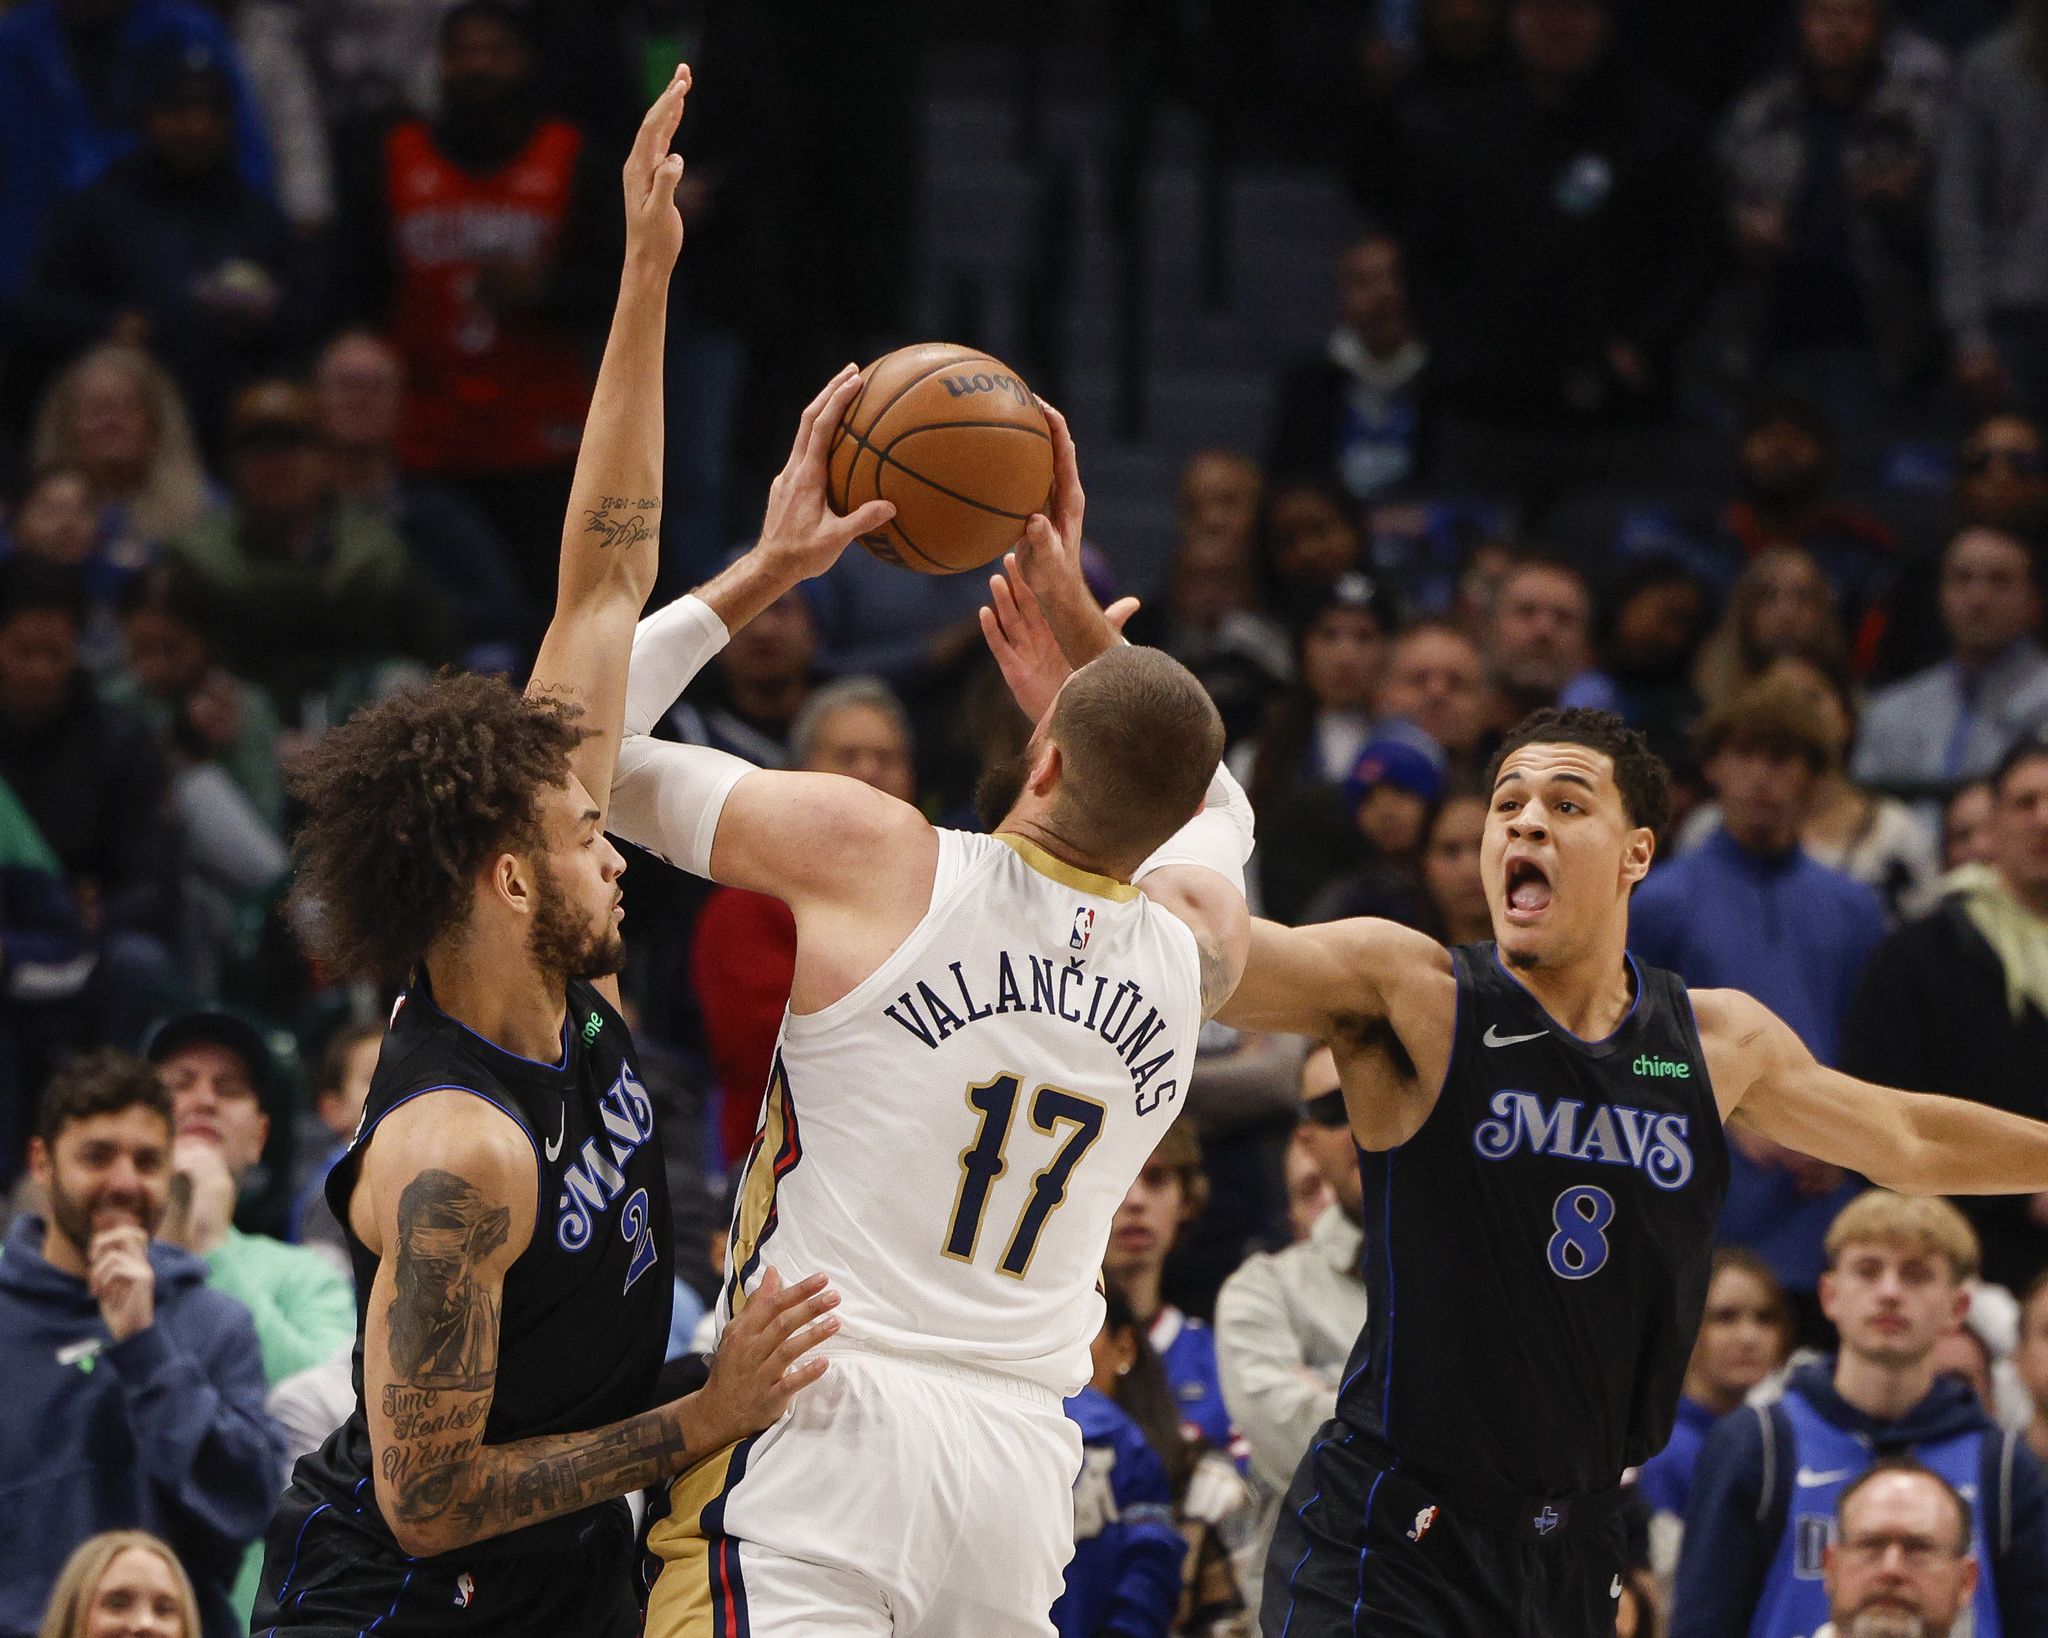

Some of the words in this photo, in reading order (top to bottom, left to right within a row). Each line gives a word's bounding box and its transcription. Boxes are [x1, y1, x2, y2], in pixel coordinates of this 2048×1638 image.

[938, 373, 1026, 407] lson
[884, 951, 1176, 1117] VALANČIŪNAS
[1632, 1054, 1690, 1079] chime
[940, 1070, 1108, 1281] 17
[1472, 1088, 1695, 1191] MAVS
[620, 1187, 658, 1297] 2
[1546, 1184, 1616, 1281] 8
[382, 1384, 438, 1417] Time
[394, 1405, 465, 1440] Heals
